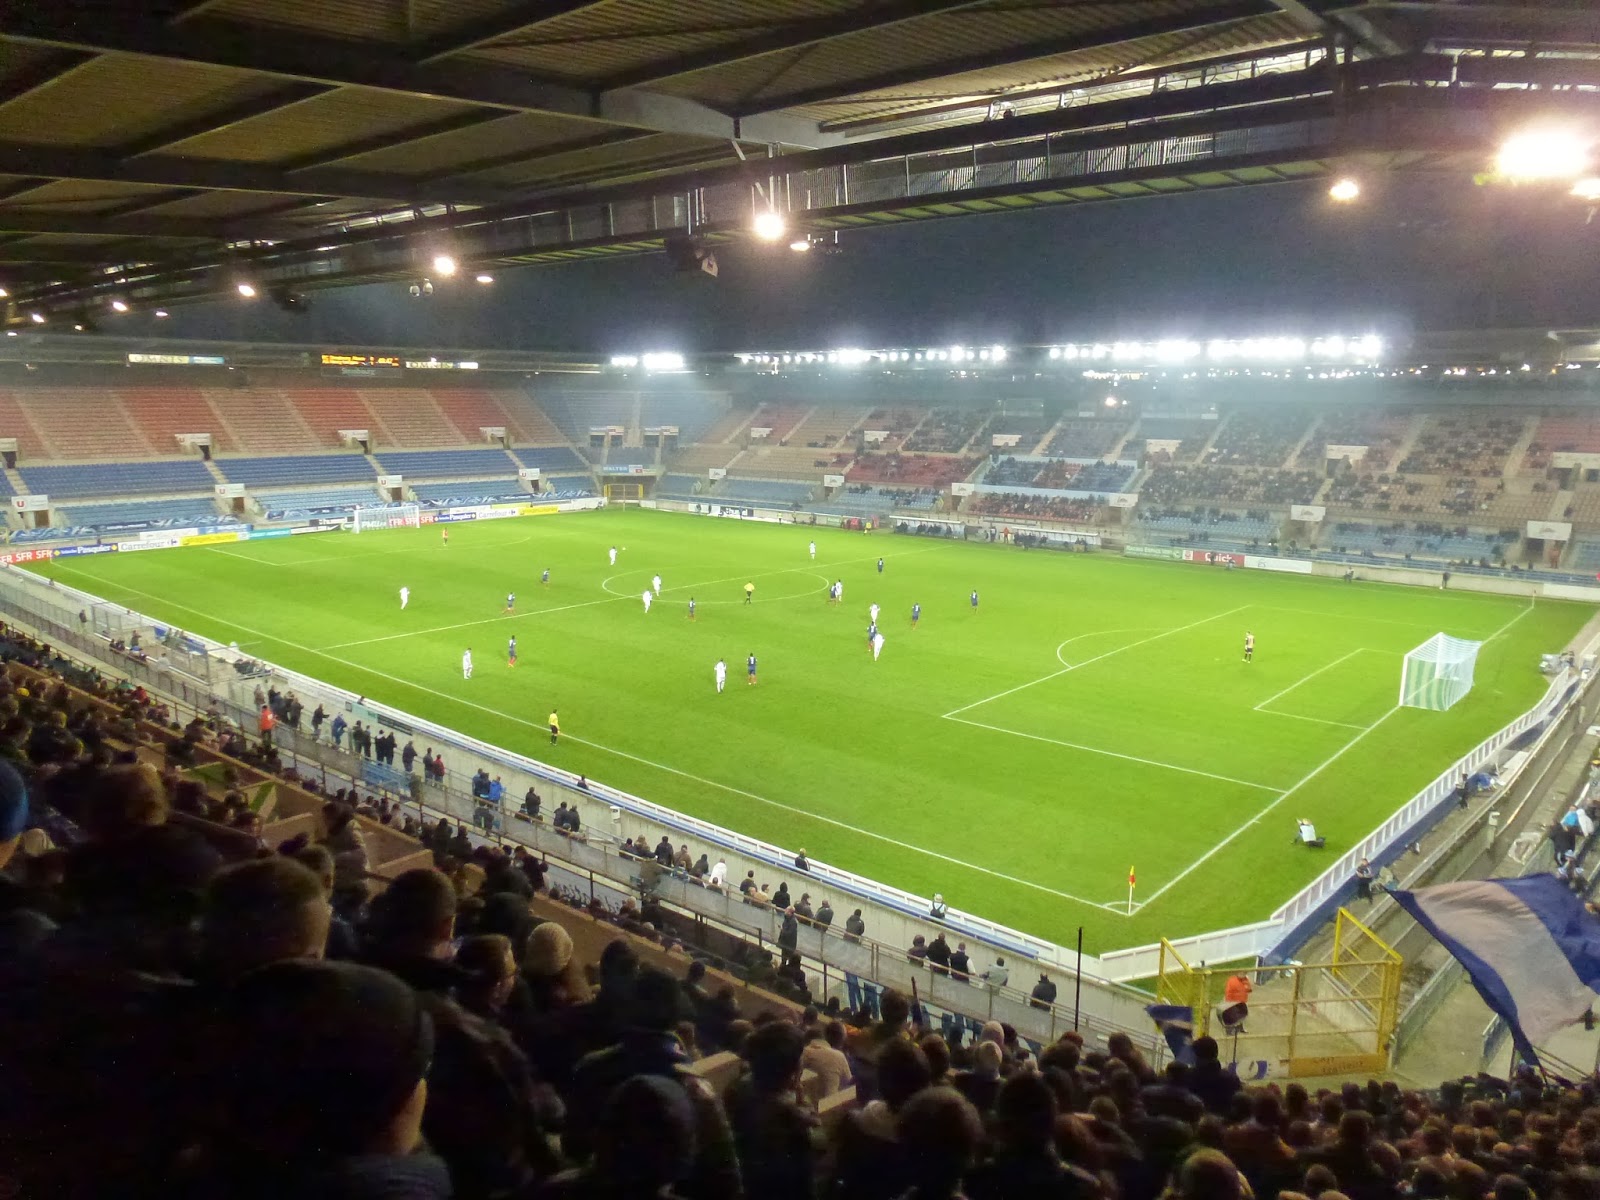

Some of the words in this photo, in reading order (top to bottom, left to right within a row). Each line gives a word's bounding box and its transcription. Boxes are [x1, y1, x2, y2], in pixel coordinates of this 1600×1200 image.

[420, 515, 434, 524] SFR
[120, 540, 165, 551] Carrefour
[15, 552, 33, 562] SFR
[35, 550, 53, 560] SFR
